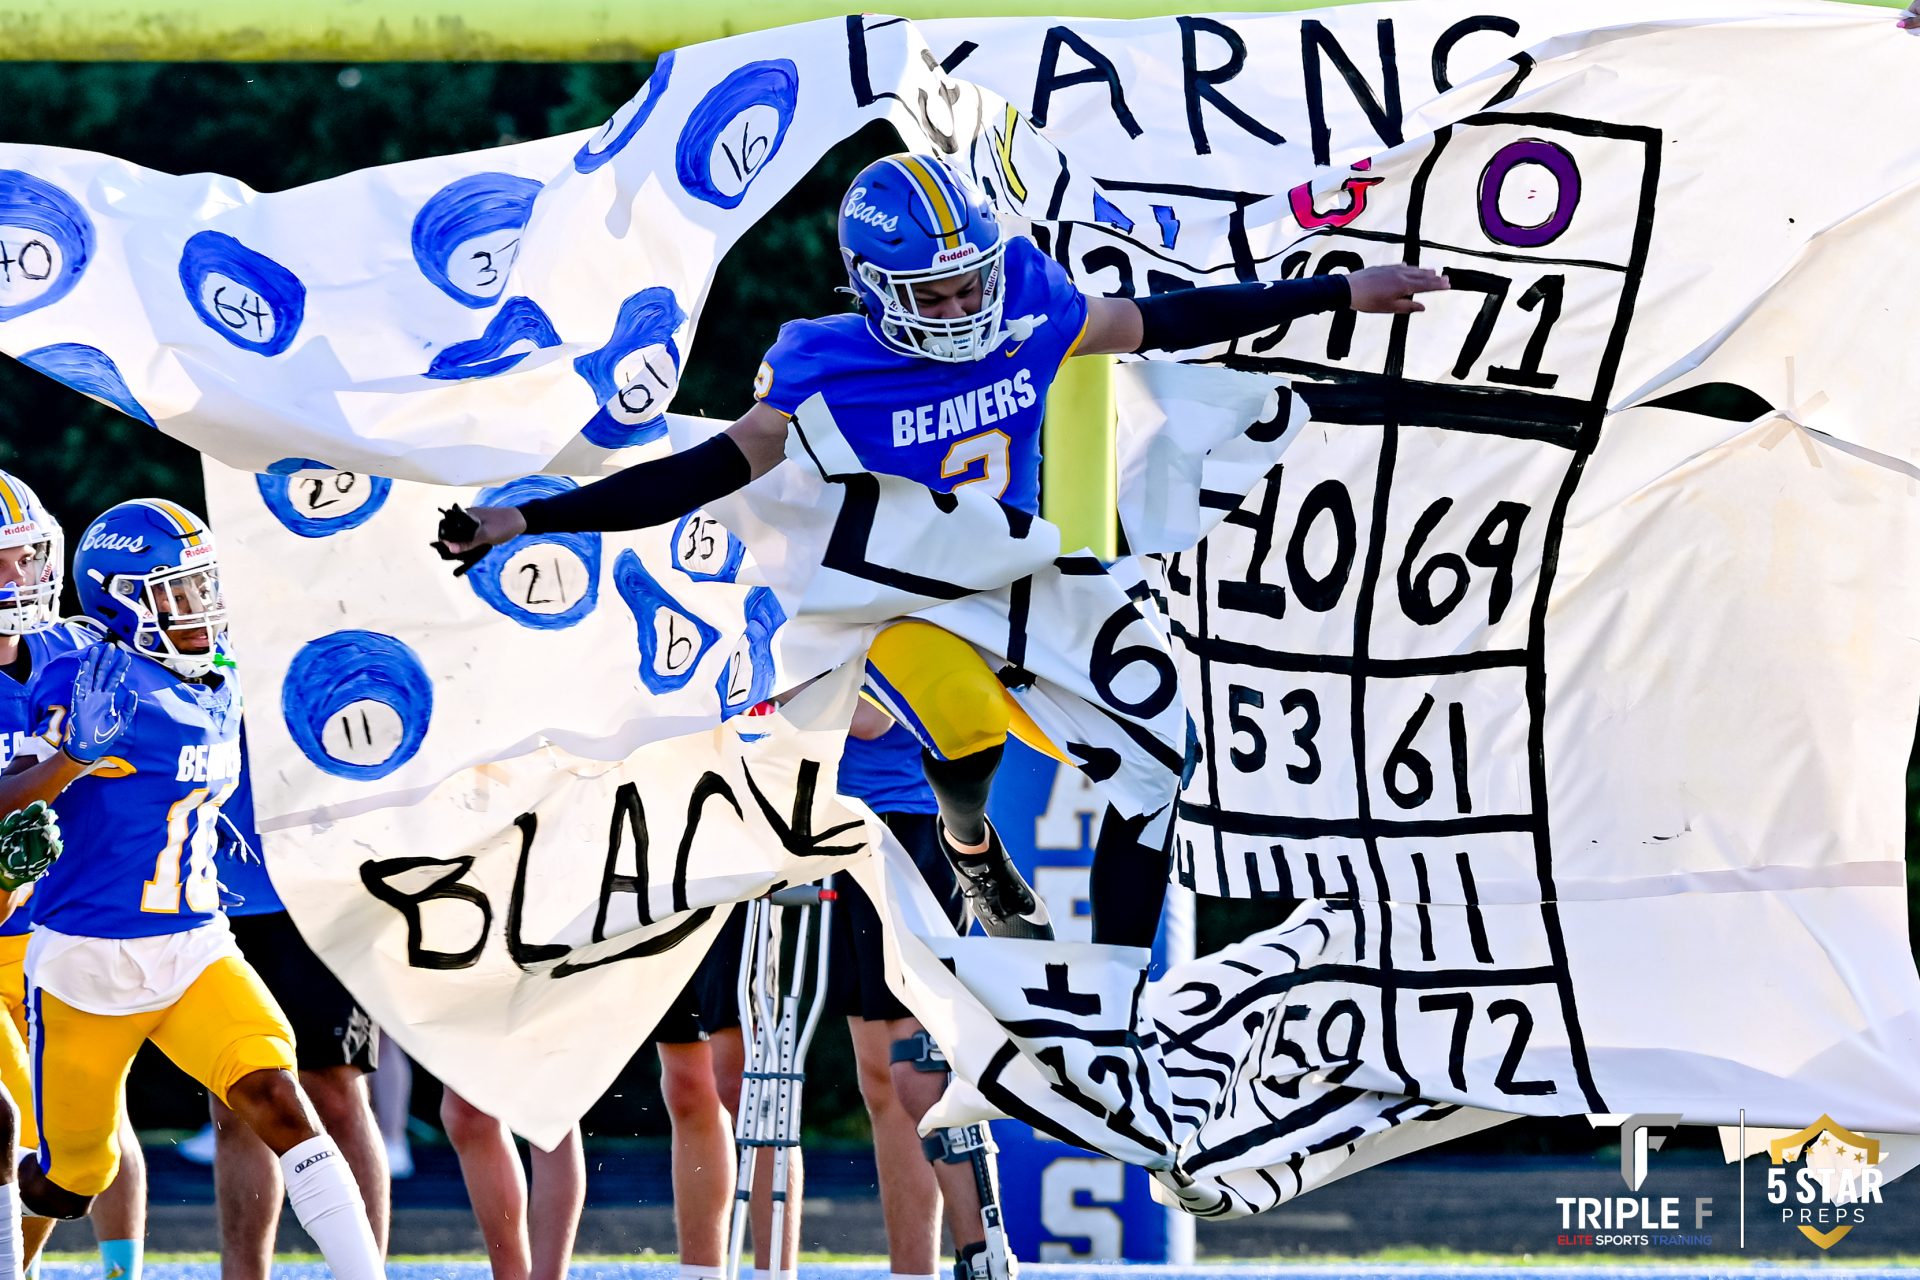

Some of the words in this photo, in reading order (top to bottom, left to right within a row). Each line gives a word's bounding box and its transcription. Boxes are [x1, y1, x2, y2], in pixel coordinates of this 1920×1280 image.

[720, 121, 767, 182] 16
[938, 246, 975, 264] Riddell
[213, 286, 269, 337] 64
[1442, 266, 1564, 389] 71
[892, 368, 1037, 447] BEAVERS
[301, 470, 354, 509] 20
[519, 557, 567, 604] 21
[1396, 496, 1532, 626] 69
[342, 709, 372, 750] 11
[1228, 683, 1322, 785] 53
[1382, 692, 1472, 814] 61
[1418, 991, 1558, 1095] 72
